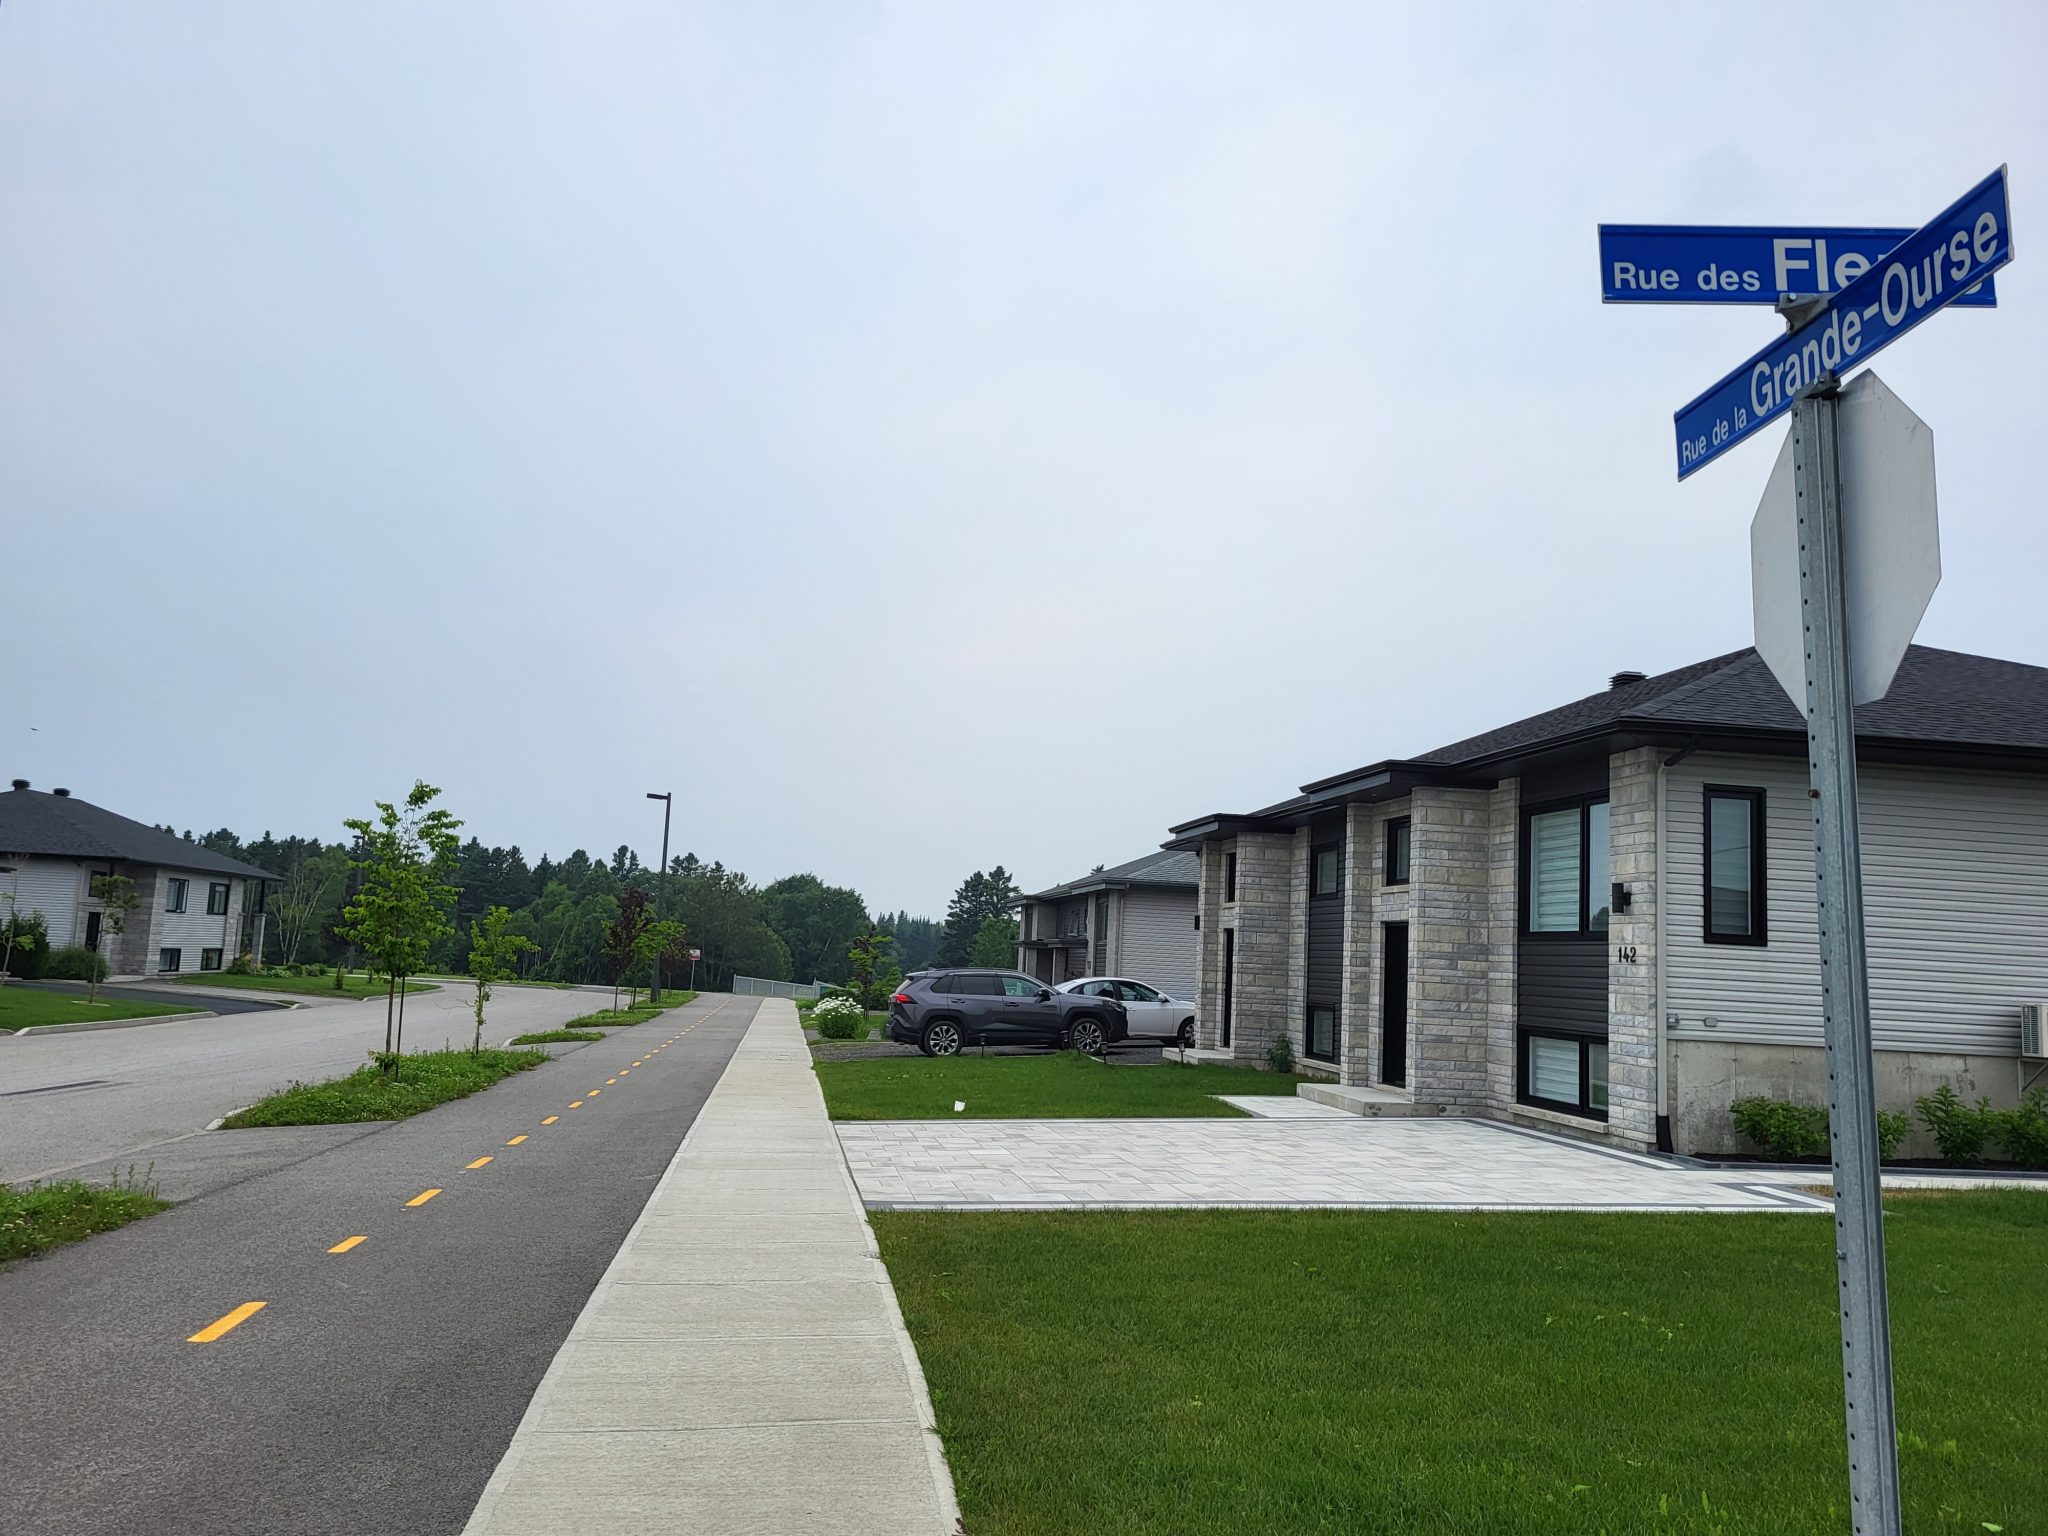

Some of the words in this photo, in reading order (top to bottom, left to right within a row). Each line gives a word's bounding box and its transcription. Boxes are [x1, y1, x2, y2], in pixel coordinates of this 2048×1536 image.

[1614, 261, 1680, 291] Rue
[1697, 263, 1761, 292] des
[1682, 439, 1707, 466] Rue
[1712, 418, 1729, 446] de
[1734, 405, 1747, 432] la
[1750, 211, 1998, 417] Grande-Ourse
[1618, 946, 1637, 963] 142
